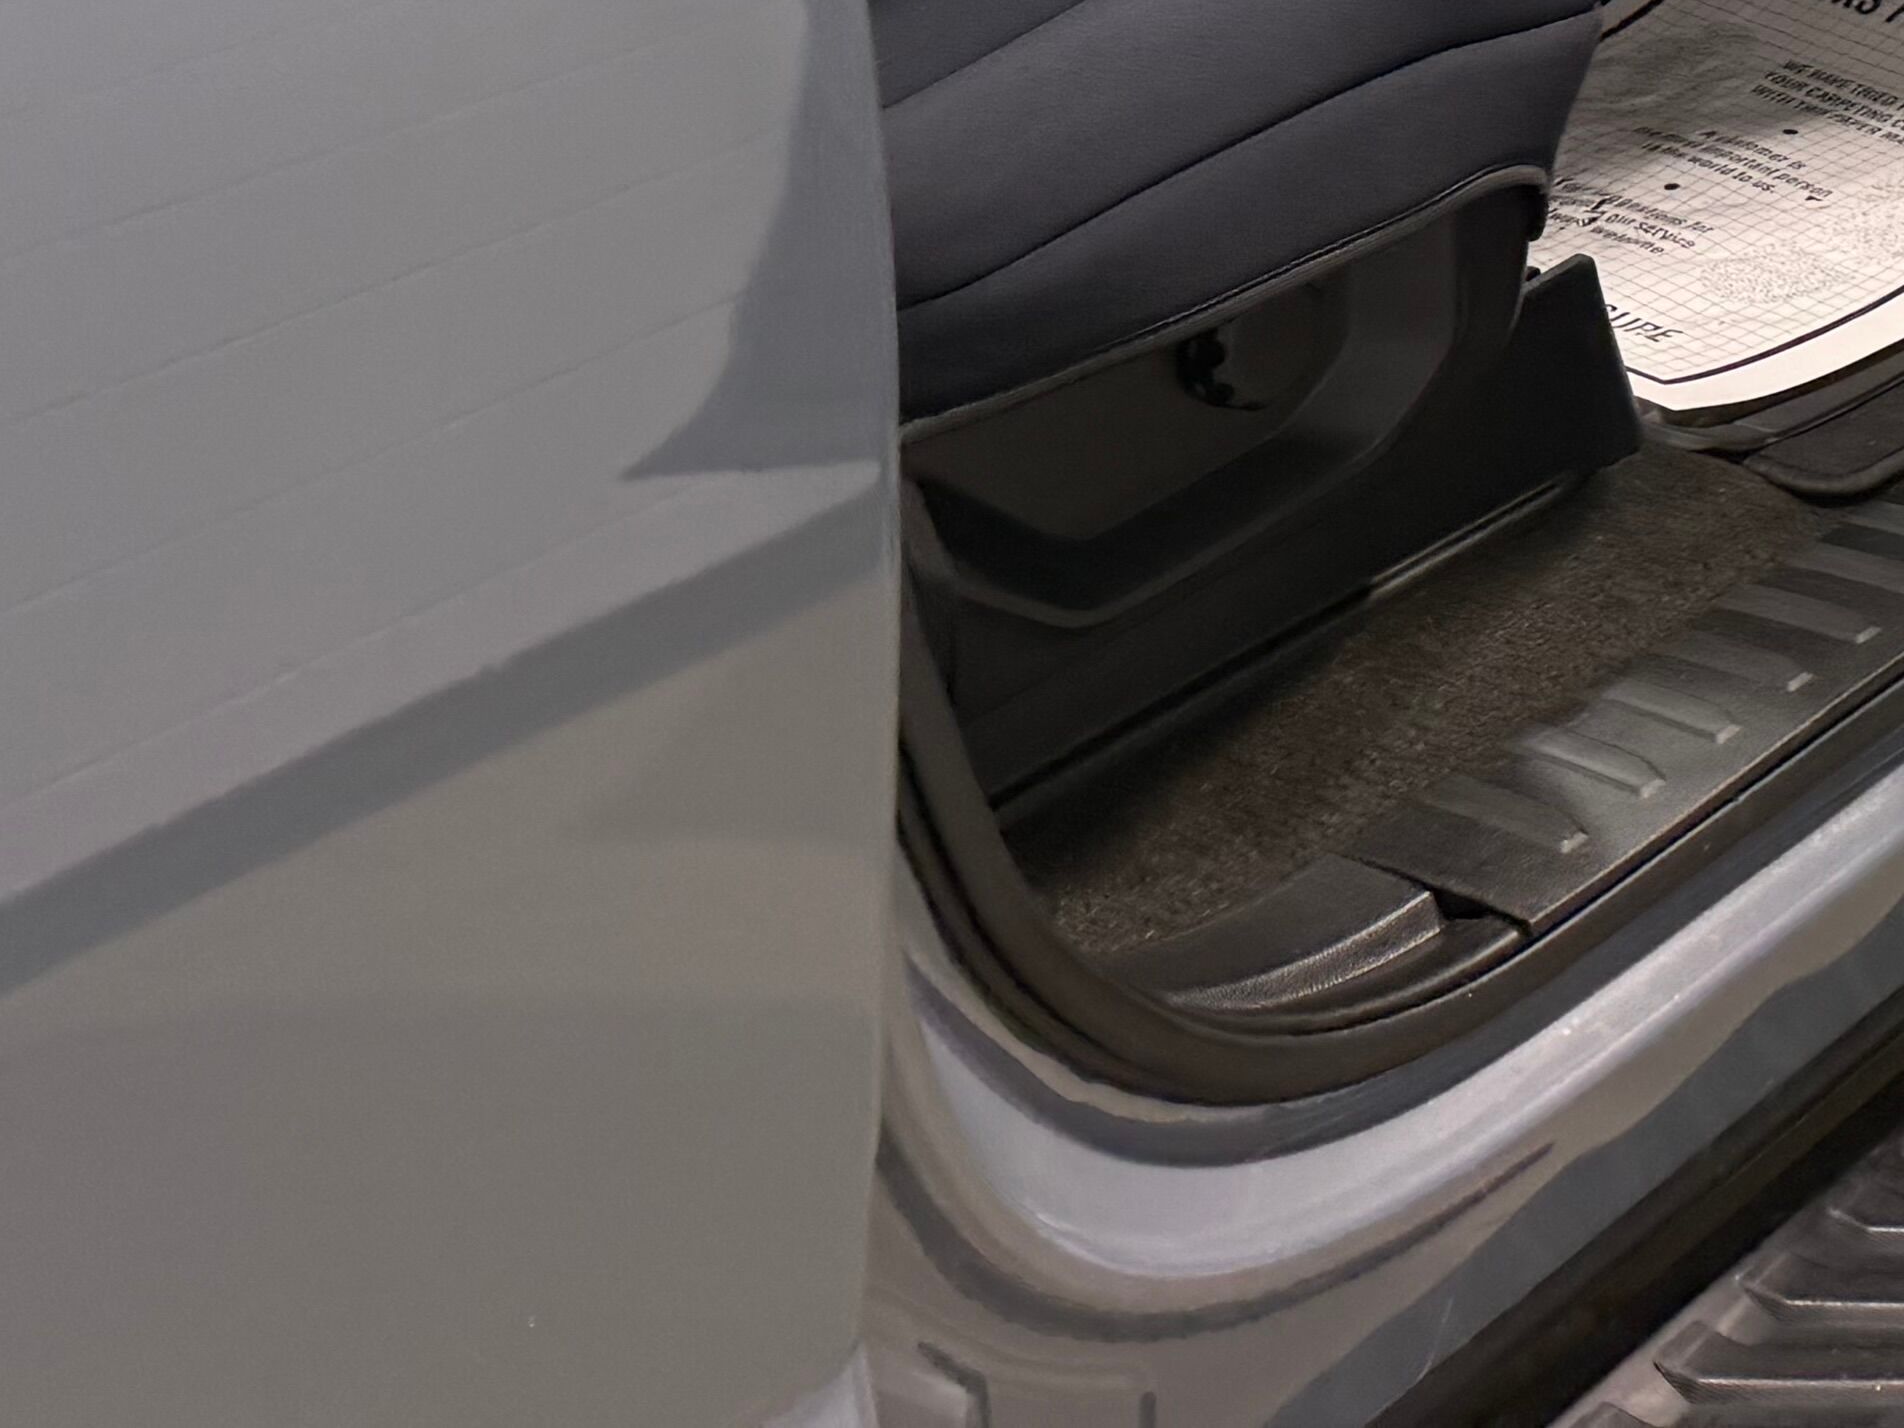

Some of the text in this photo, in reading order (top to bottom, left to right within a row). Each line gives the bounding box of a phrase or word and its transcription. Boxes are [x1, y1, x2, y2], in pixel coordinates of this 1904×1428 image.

[1731, 171, 1753, 183] to
[1751, 179, 1777, 194] us.
[1773, 172, 1835, 198] person
[1633, 221, 1697, 250] service
